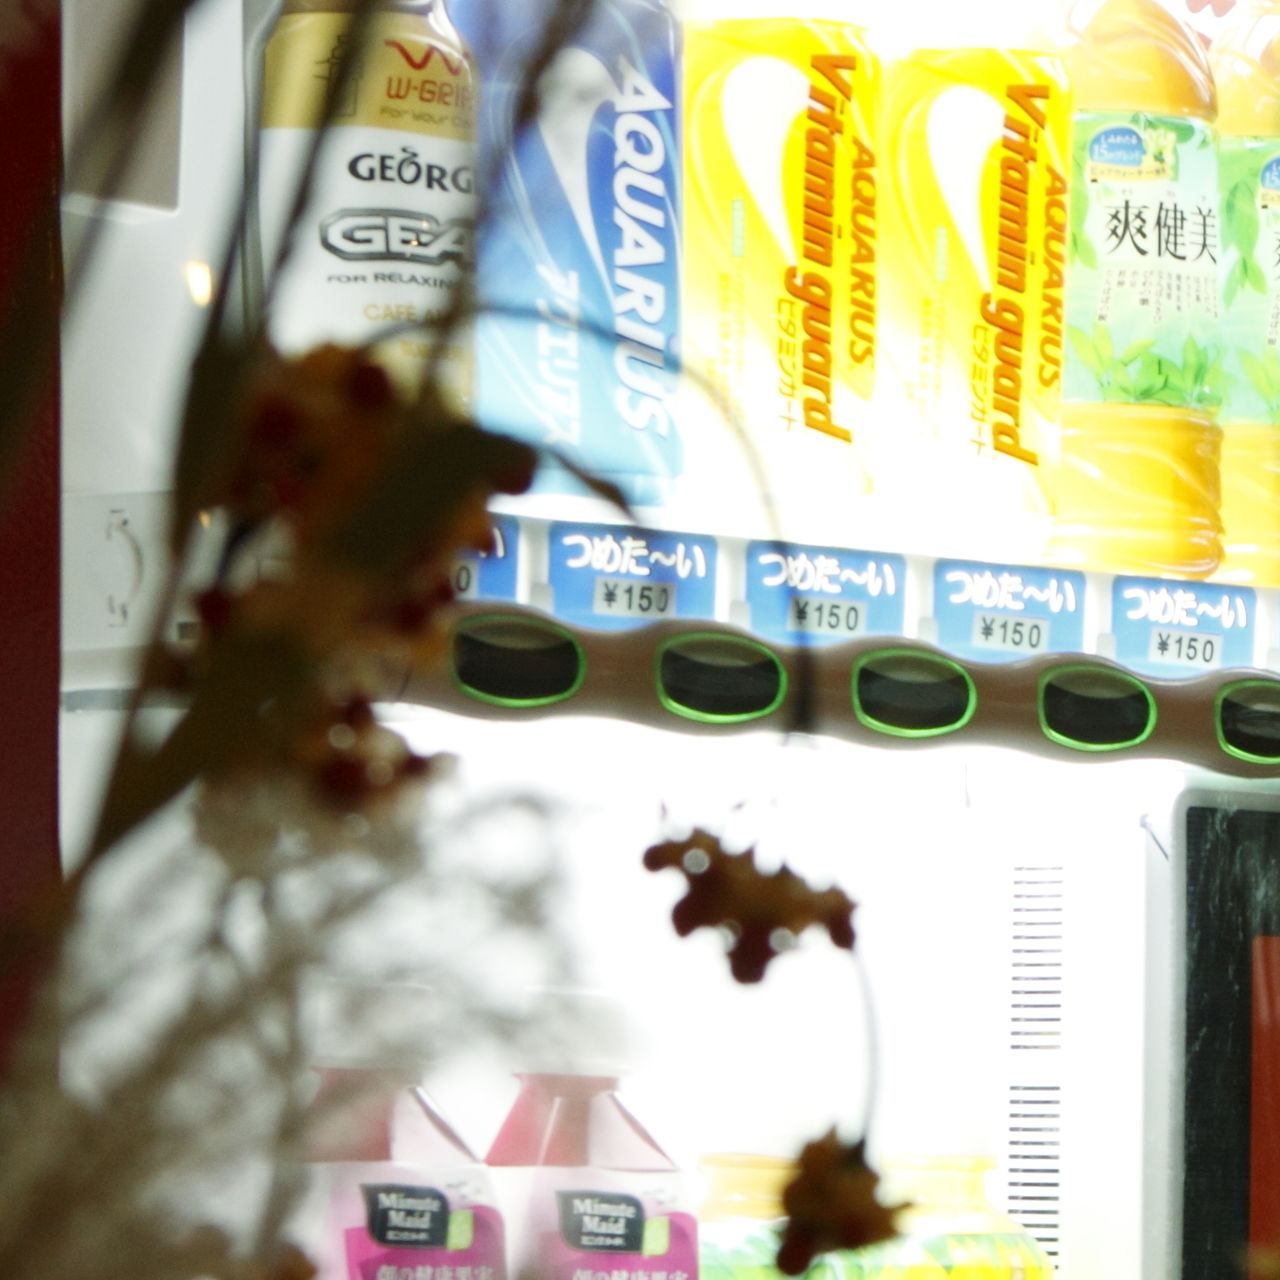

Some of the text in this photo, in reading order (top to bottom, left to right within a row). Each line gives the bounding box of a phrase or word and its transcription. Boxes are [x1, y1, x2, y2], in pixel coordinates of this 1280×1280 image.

[612, 52, 674, 440] AQUARIUS
[784, 53, 857, 443] Vitamin guard
[848, 137, 879, 366] AQUARIUS
[979, 83, 1050, 467] Vitamin guard
[1037, 164, 1069, 390] AQUARIUS
[1103, 199, 1218, 265] 爽健美
[602, 580, 671, 612] ¥150
[795, 598, 859, 632] ¥150
[980, 616, 1043, 649] ¥150
[1156, 630, 1215, 663] ¥150
